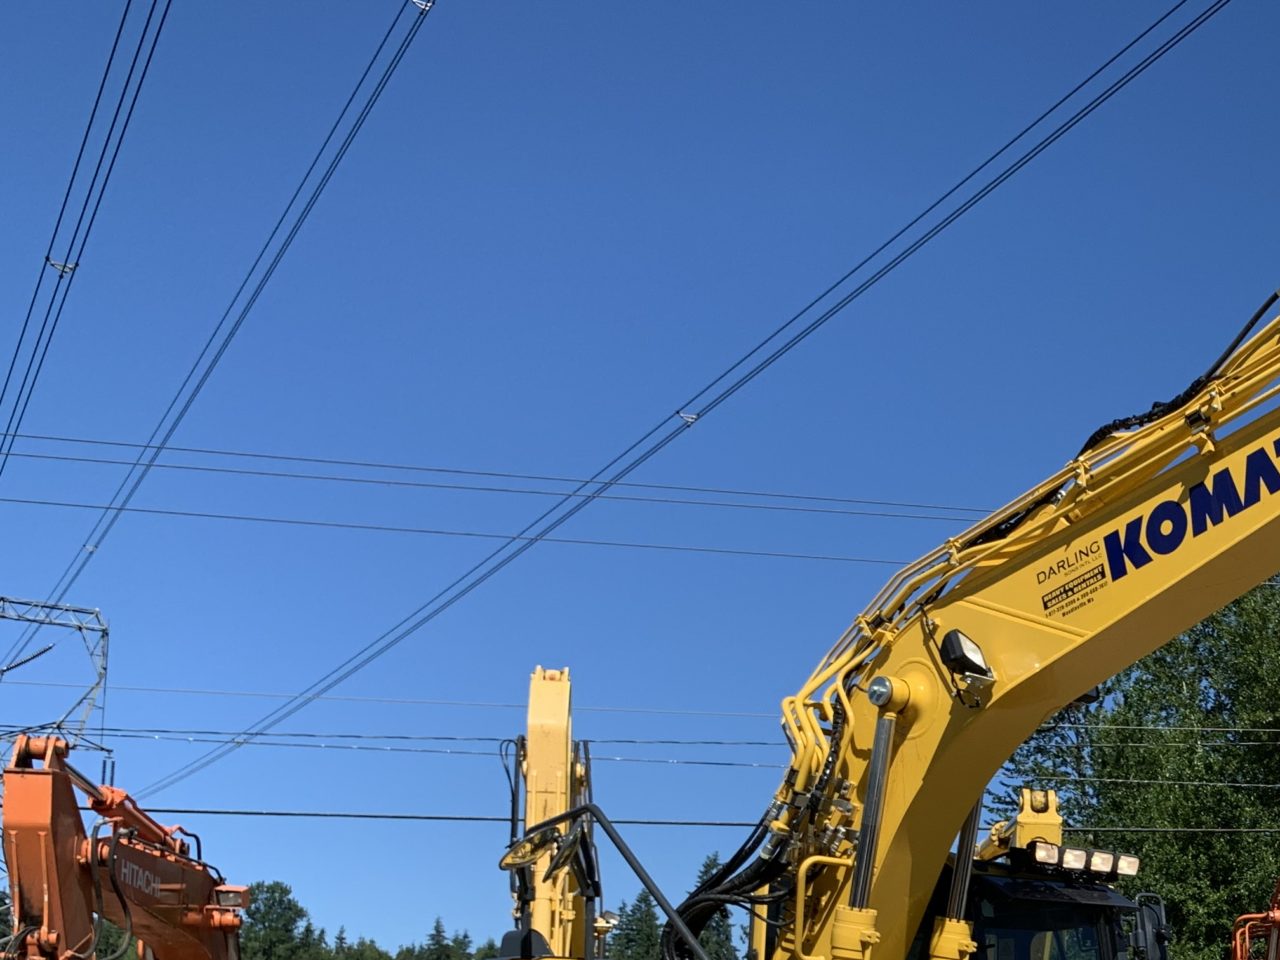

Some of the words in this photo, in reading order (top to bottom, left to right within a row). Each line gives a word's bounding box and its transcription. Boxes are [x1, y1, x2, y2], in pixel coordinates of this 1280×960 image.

[1036, 541, 1101, 584] DARLING
[1043, 586, 1065, 602] HEAVY
[1065, 565, 1104, 591] EQUIPMENT
[1046, 592, 1068, 608] SALES
[1073, 573, 1103, 594] RENTALS
[121, 859, 161, 898] HITACHI
